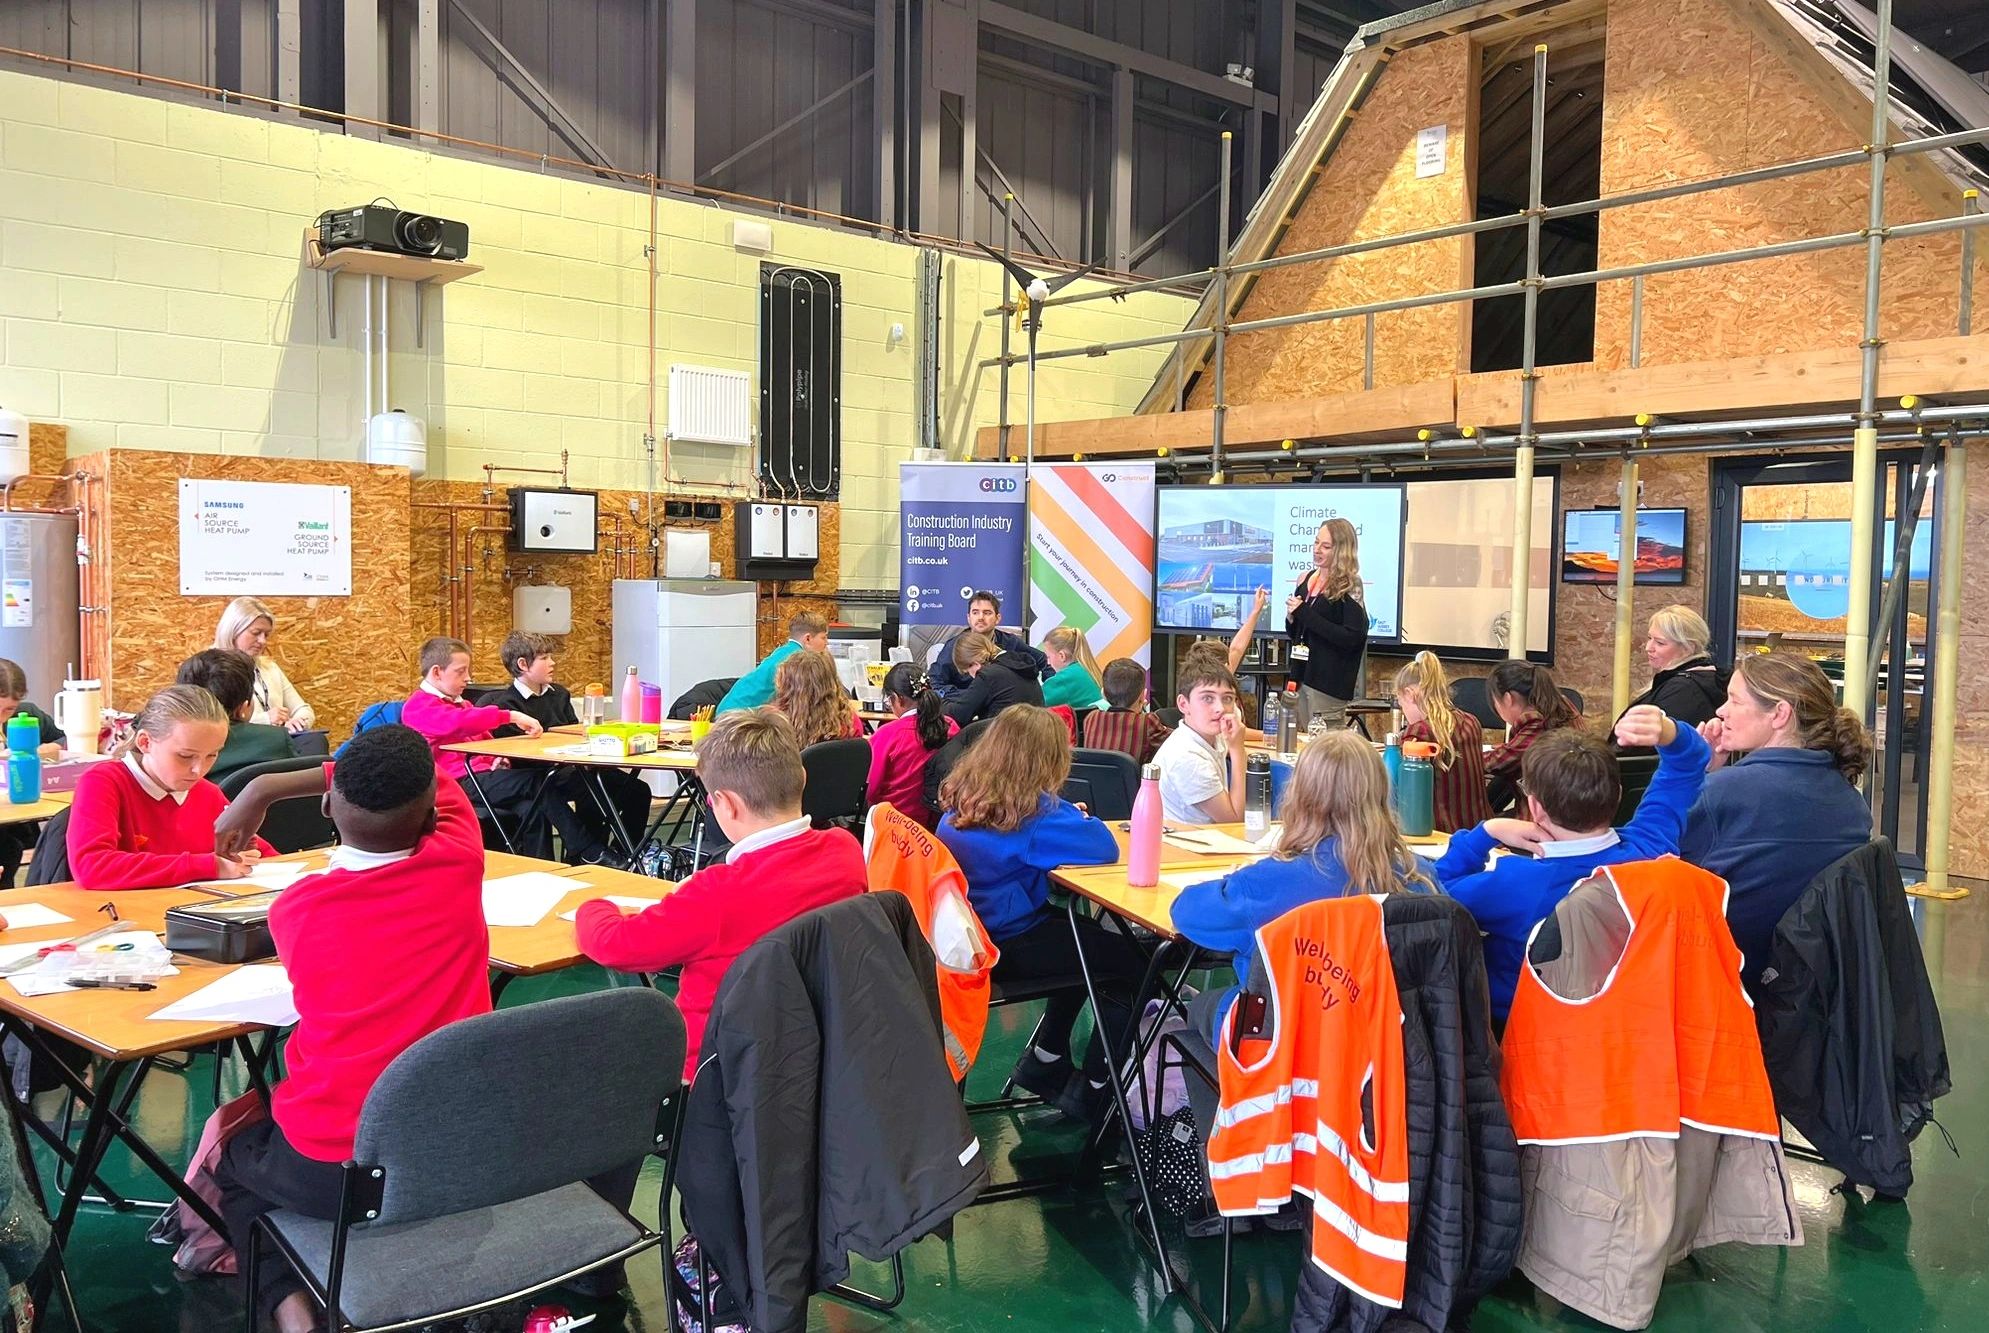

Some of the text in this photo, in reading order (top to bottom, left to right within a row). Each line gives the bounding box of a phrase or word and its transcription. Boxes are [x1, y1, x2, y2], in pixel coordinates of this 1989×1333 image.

[982, 478, 1015, 490] citb
[204, 501, 244, 509] SAMSUNG
[1290, 506, 1337, 518] Climate
[204, 519, 239, 527] SOURCE
[907, 513, 1013, 533] Construction Industry
[1290, 523, 1320, 536] Chan
[294, 533, 329, 541] GROUND
[906, 532, 976, 551] Training Board
[907, 556, 949, 565] citb.co.uk
[1036, 533, 1119, 623] Start your journey in construction
[1294, 937, 1361, 1004] Welbeing
